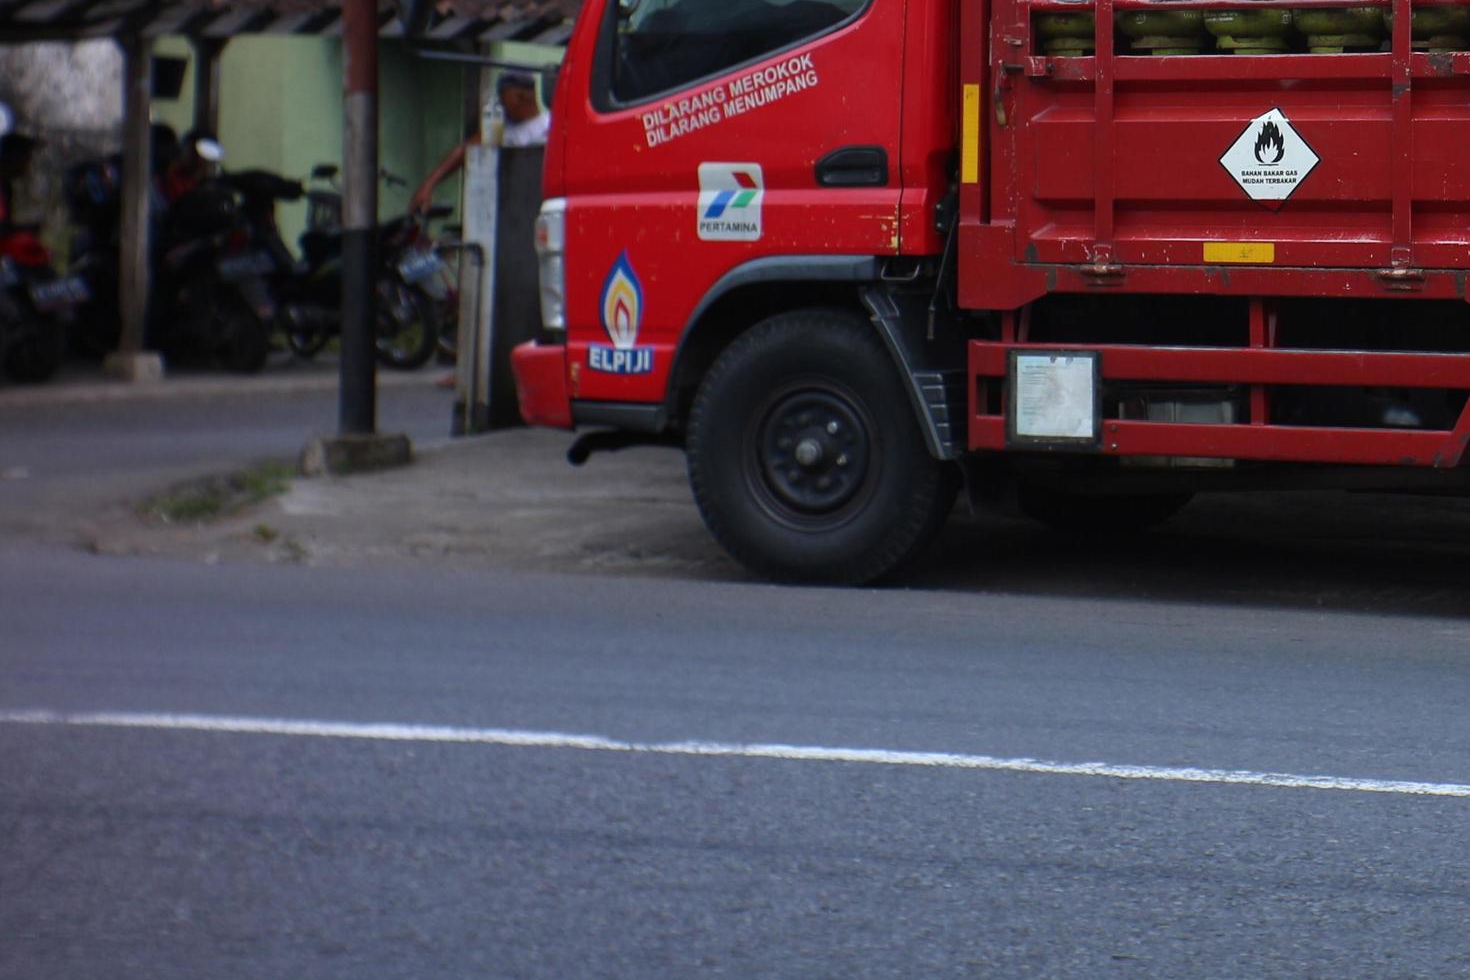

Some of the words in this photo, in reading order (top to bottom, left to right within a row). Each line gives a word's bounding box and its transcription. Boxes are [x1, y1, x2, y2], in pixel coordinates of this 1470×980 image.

[642, 86, 726, 130] DILARANG
[729, 53, 815, 98] MEROKOK
[646, 107, 721, 148] DILARANG
[723, 69, 819, 119] MENUMPANG
[699, 222, 758, 234] PERTAMINA
[588, 347, 650, 373] ELPIJI
